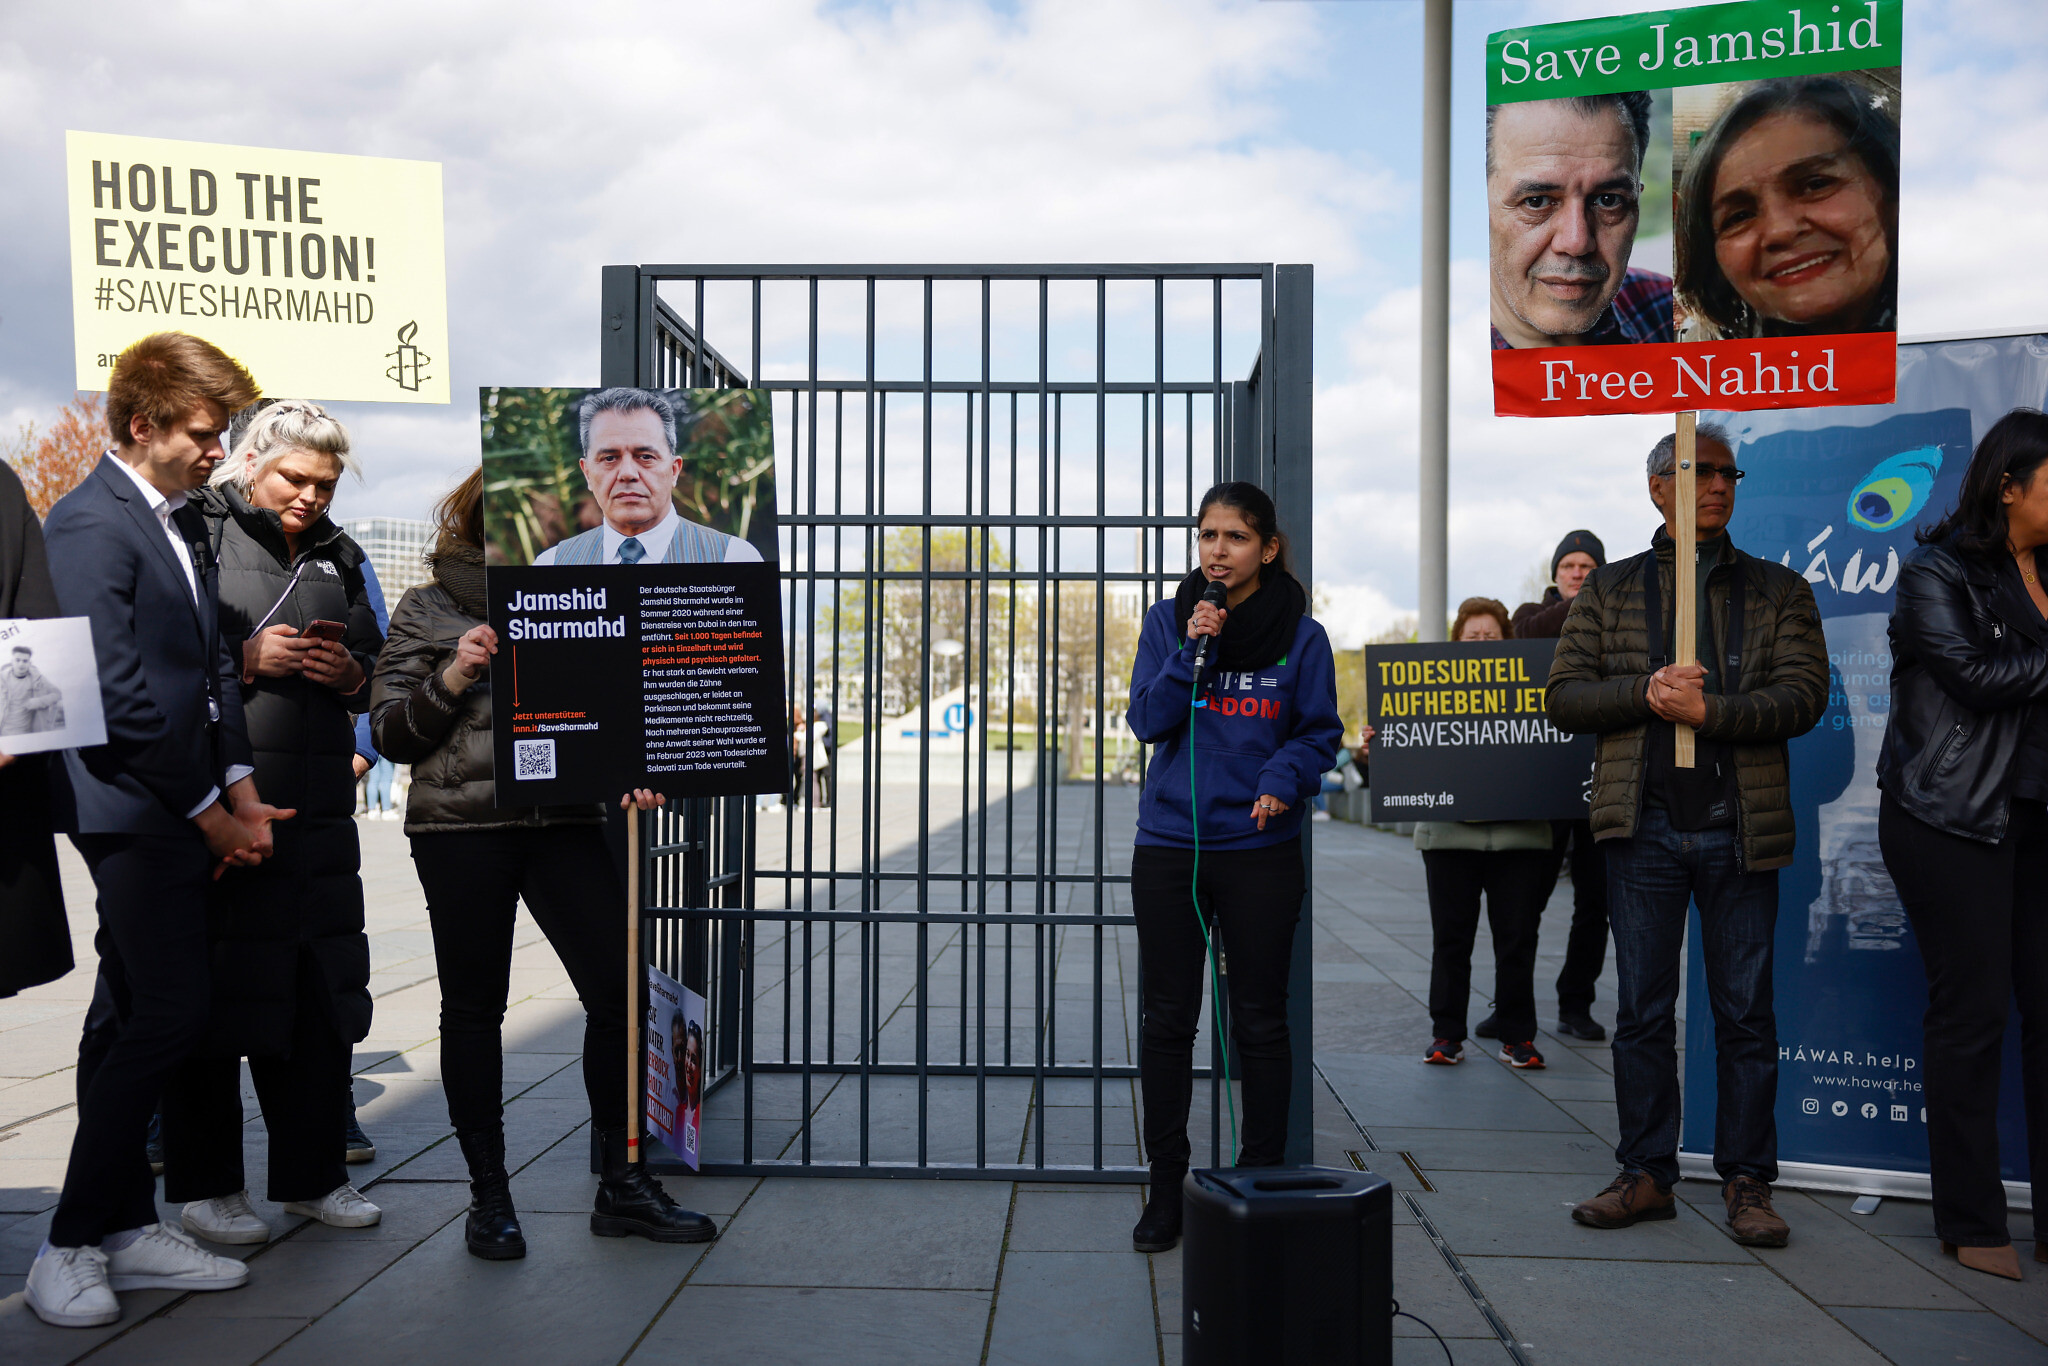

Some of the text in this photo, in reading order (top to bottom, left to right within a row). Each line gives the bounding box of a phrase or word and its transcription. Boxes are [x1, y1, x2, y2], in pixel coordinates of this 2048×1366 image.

[1500, 2, 1882, 85] Save Jamshid
[92, 160, 323, 225] HOLD THE
[95, 218, 376, 283] EXECUTION!
[95, 278, 374, 325] #SAVESHARMAHD
[1540, 349, 1839, 402] Free Nahid
[689, 585, 735, 593] Staatsbürger
[508, 588, 606, 612] Jamshid
[640, 598, 671, 606] Jamshid
[673, 597, 710, 605] Sharmahd
[711, 596, 733, 604] wurde
[693, 608, 724, 616] während
[509, 616, 626, 640] Sharmahd
[641, 621, 682, 629] Dienstreise
[698, 620, 718, 628] Dubai
[711, 632, 732, 640] Tagen
[677, 644, 711, 652] Einzelhaft
[643, 657, 675, 666] physisch
[692, 655, 727, 664] psychisch
[729, 655, 761, 664] gefoltert.
[666, 668, 685, 676] stark
[697, 667, 726, 675] Gewicht
[1378, 658, 1530, 686] TODESURTEIL
[644, 692, 701, 701] ausgeschlagen,
[1380, 689, 1506, 717] AUFHEBEN!
[535, 711, 586, 719] unterstützen:
[715, 713, 753, 722] rechtzeitig.
[513, 722, 598, 732] innn.it/SaveSharmahd
[702, 726, 761, 734] Schauprozessen
[716, 737, 734, 745] Wahl
[723, 748, 767, 756] Todesrichter
[647, 764, 676, 772] Salavati
[713, 761, 747, 769] verurteilt.
[1383, 792, 1454, 808] amnesty.de
[1779, 1045, 1916, 1072] HÁWAR.help
